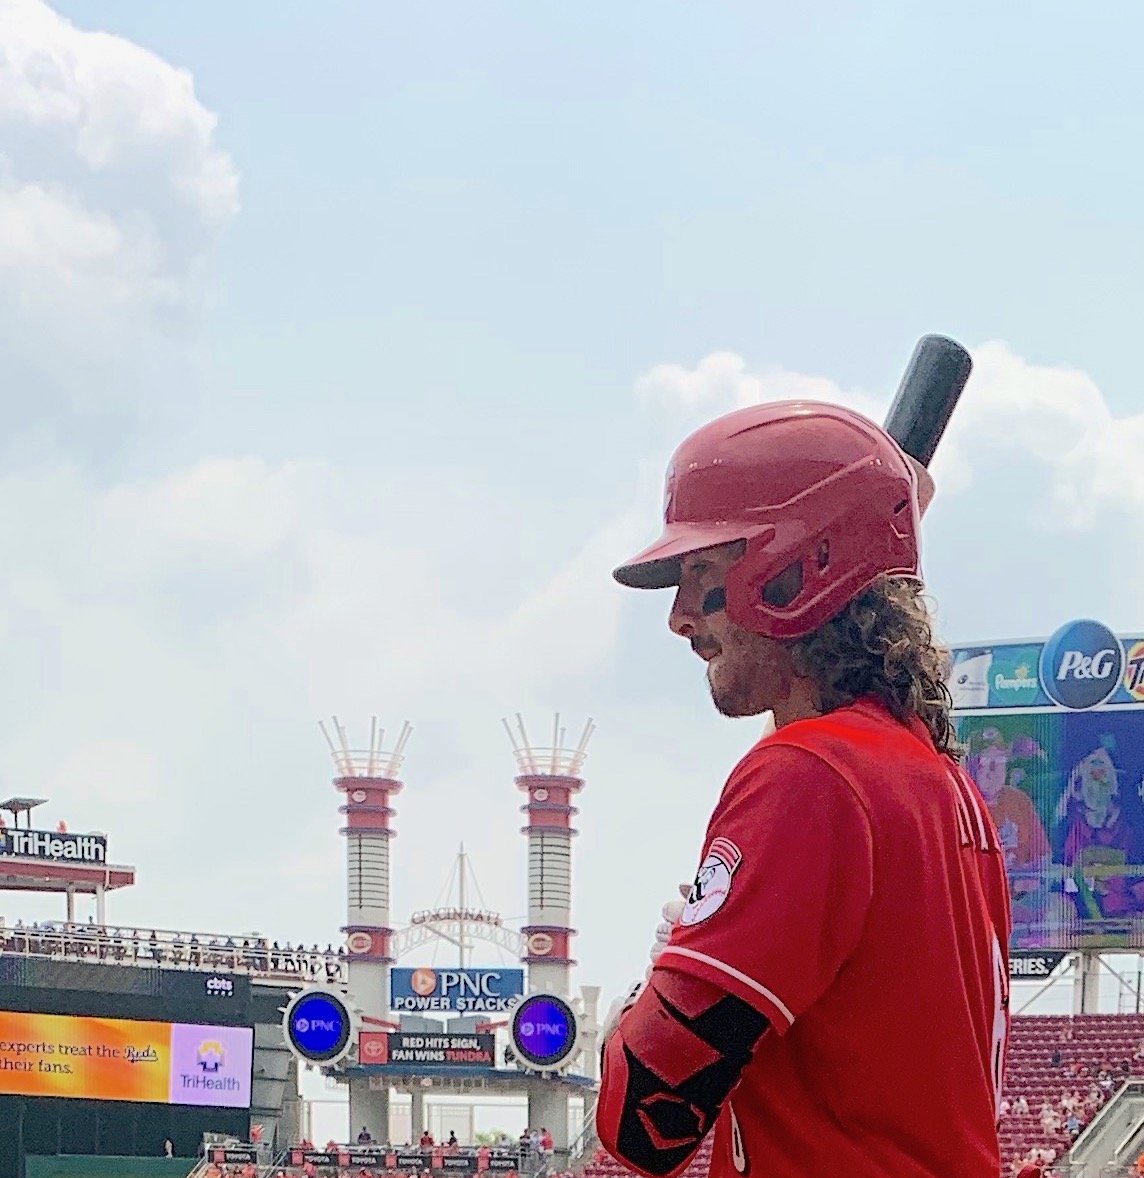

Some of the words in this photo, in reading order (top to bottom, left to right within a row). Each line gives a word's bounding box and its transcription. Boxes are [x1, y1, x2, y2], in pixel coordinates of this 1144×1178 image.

[1056, 649, 1115, 680] P&G
[995, 673, 1037, 691] Pampers
[8, 830, 105, 862] TriHealth
[411, 907, 502, 926] CINCINNATI
[206, 977, 233, 990] cbts
[440, 972, 501, 997] PNC
[394, 997, 450, 1010] POWER
[456, 998, 518, 1012] STACKS
[311, 1020, 339, 1031] PNC
[536, 1023, 565, 1036] PNC
[0, 1041, 54, 1057] experts
[58, 1043, 93, 1057] treat
[96, 1044, 120, 1058] the
[402, 1037, 424, 1048] RED
[425, 1037, 449, 1048] HITS
[450, 1038, 481, 1050] SIGN,
[392, 1050, 415, 1060] FAN
[415, 1051, 445, 1061] WINS
[446, 1051, 491, 1061] TUNDRA
[38, 1059, 73, 1074] fans.
[181, 1074, 240, 1091] TriHealth
